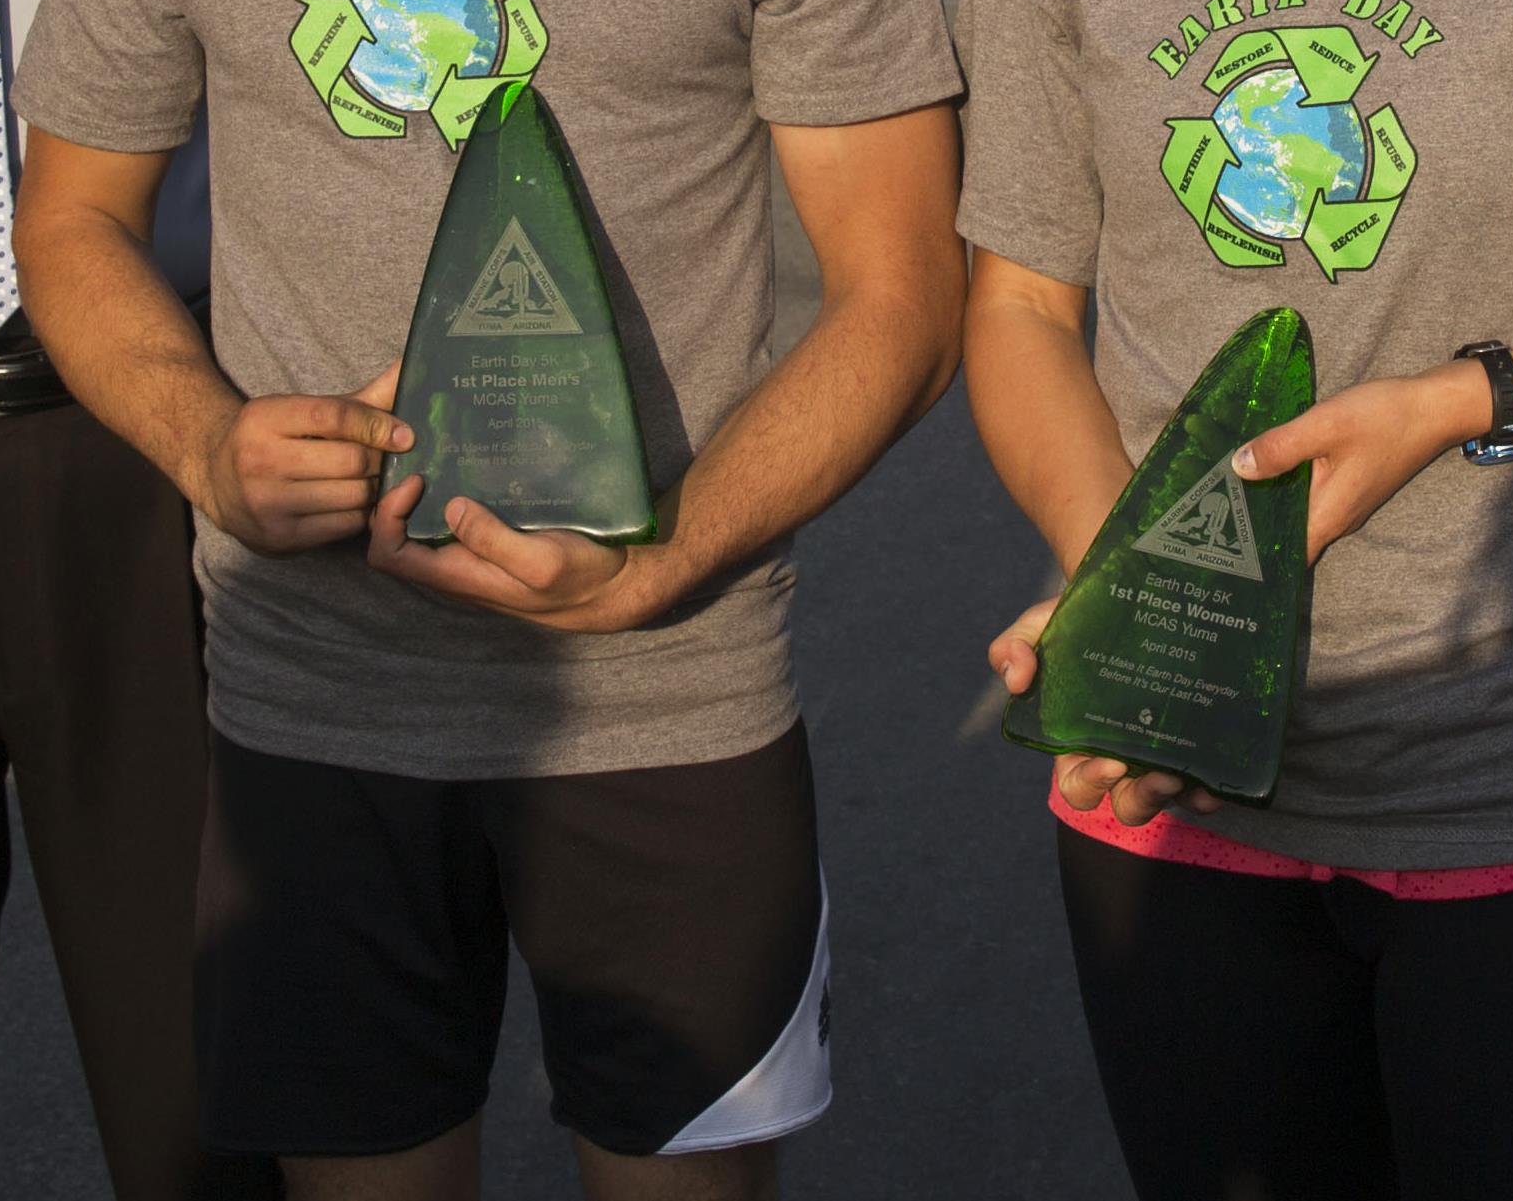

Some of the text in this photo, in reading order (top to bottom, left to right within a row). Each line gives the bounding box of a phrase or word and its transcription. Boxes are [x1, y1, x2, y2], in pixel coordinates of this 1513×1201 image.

[308, 12, 348, 67] RETHINK
[510, 9, 539, 51] REUSE
[1214, 42, 1274, 80] RESTORE
[1309, 40, 1356, 74] REDUCE
[333, 95, 403, 134] REPLENISH
[1179, 134, 1212, 194] RETHINK
[1375, 127, 1407, 173] REUSE
[1206, 222, 1281, 263] REPLENISH
[1329, 213, 1381, 253] RECYCLE
[535, 270, 559, 303] STATION
[512, 321, 552, 330] ARIZONA
[471, 354, 560, 370] Earth Day 5K
[452, 373, 580, 388] 1st Place Men's
[473, 392, 559, 406] MCAS Yuma
[488, 417, 513, 430] April
[1160, 477, 1216, 528] MARINE CORPS
[1230, 486, 1249, 544] AIR STATION
[1162, 543, 1235, 568] YUMA ARIZONA
[1145, 572, 1233, 605] Earth Day 5K
[1109, 583, 1259, 633] 1st Place Women's
[1134, 609, 1218, 643] MCAS Yuma
[1140, 638, 1197, 662] April 2015
[1082, 649, 1240, 699] Let's Make It Earth Day Everyday
[1098, 667, 1132, 685] Before
[1133, 676, 1148, 689] It's
[1150, 681, 1169, 694] Our
[1170, 687, 1192, 701] Last
[1124, 722, 1144, 734] 100%
